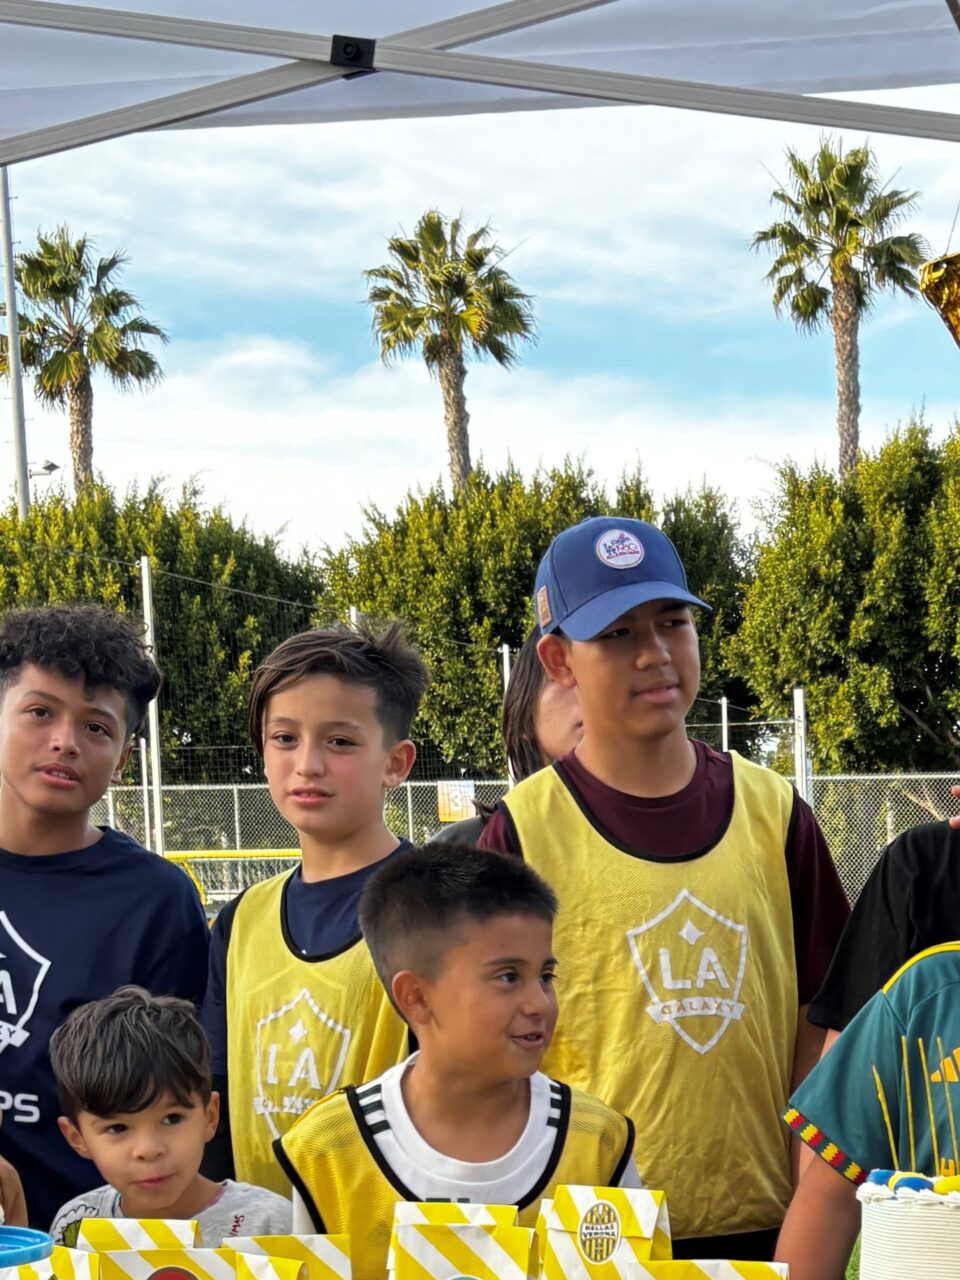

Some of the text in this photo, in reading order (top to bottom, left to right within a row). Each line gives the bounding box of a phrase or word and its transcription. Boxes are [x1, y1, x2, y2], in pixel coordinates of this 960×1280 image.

[659, 947, 730, 989] LA
[660, 999, 736, 1016] GALAXY
[266, 1043, 321, 1090] LA
